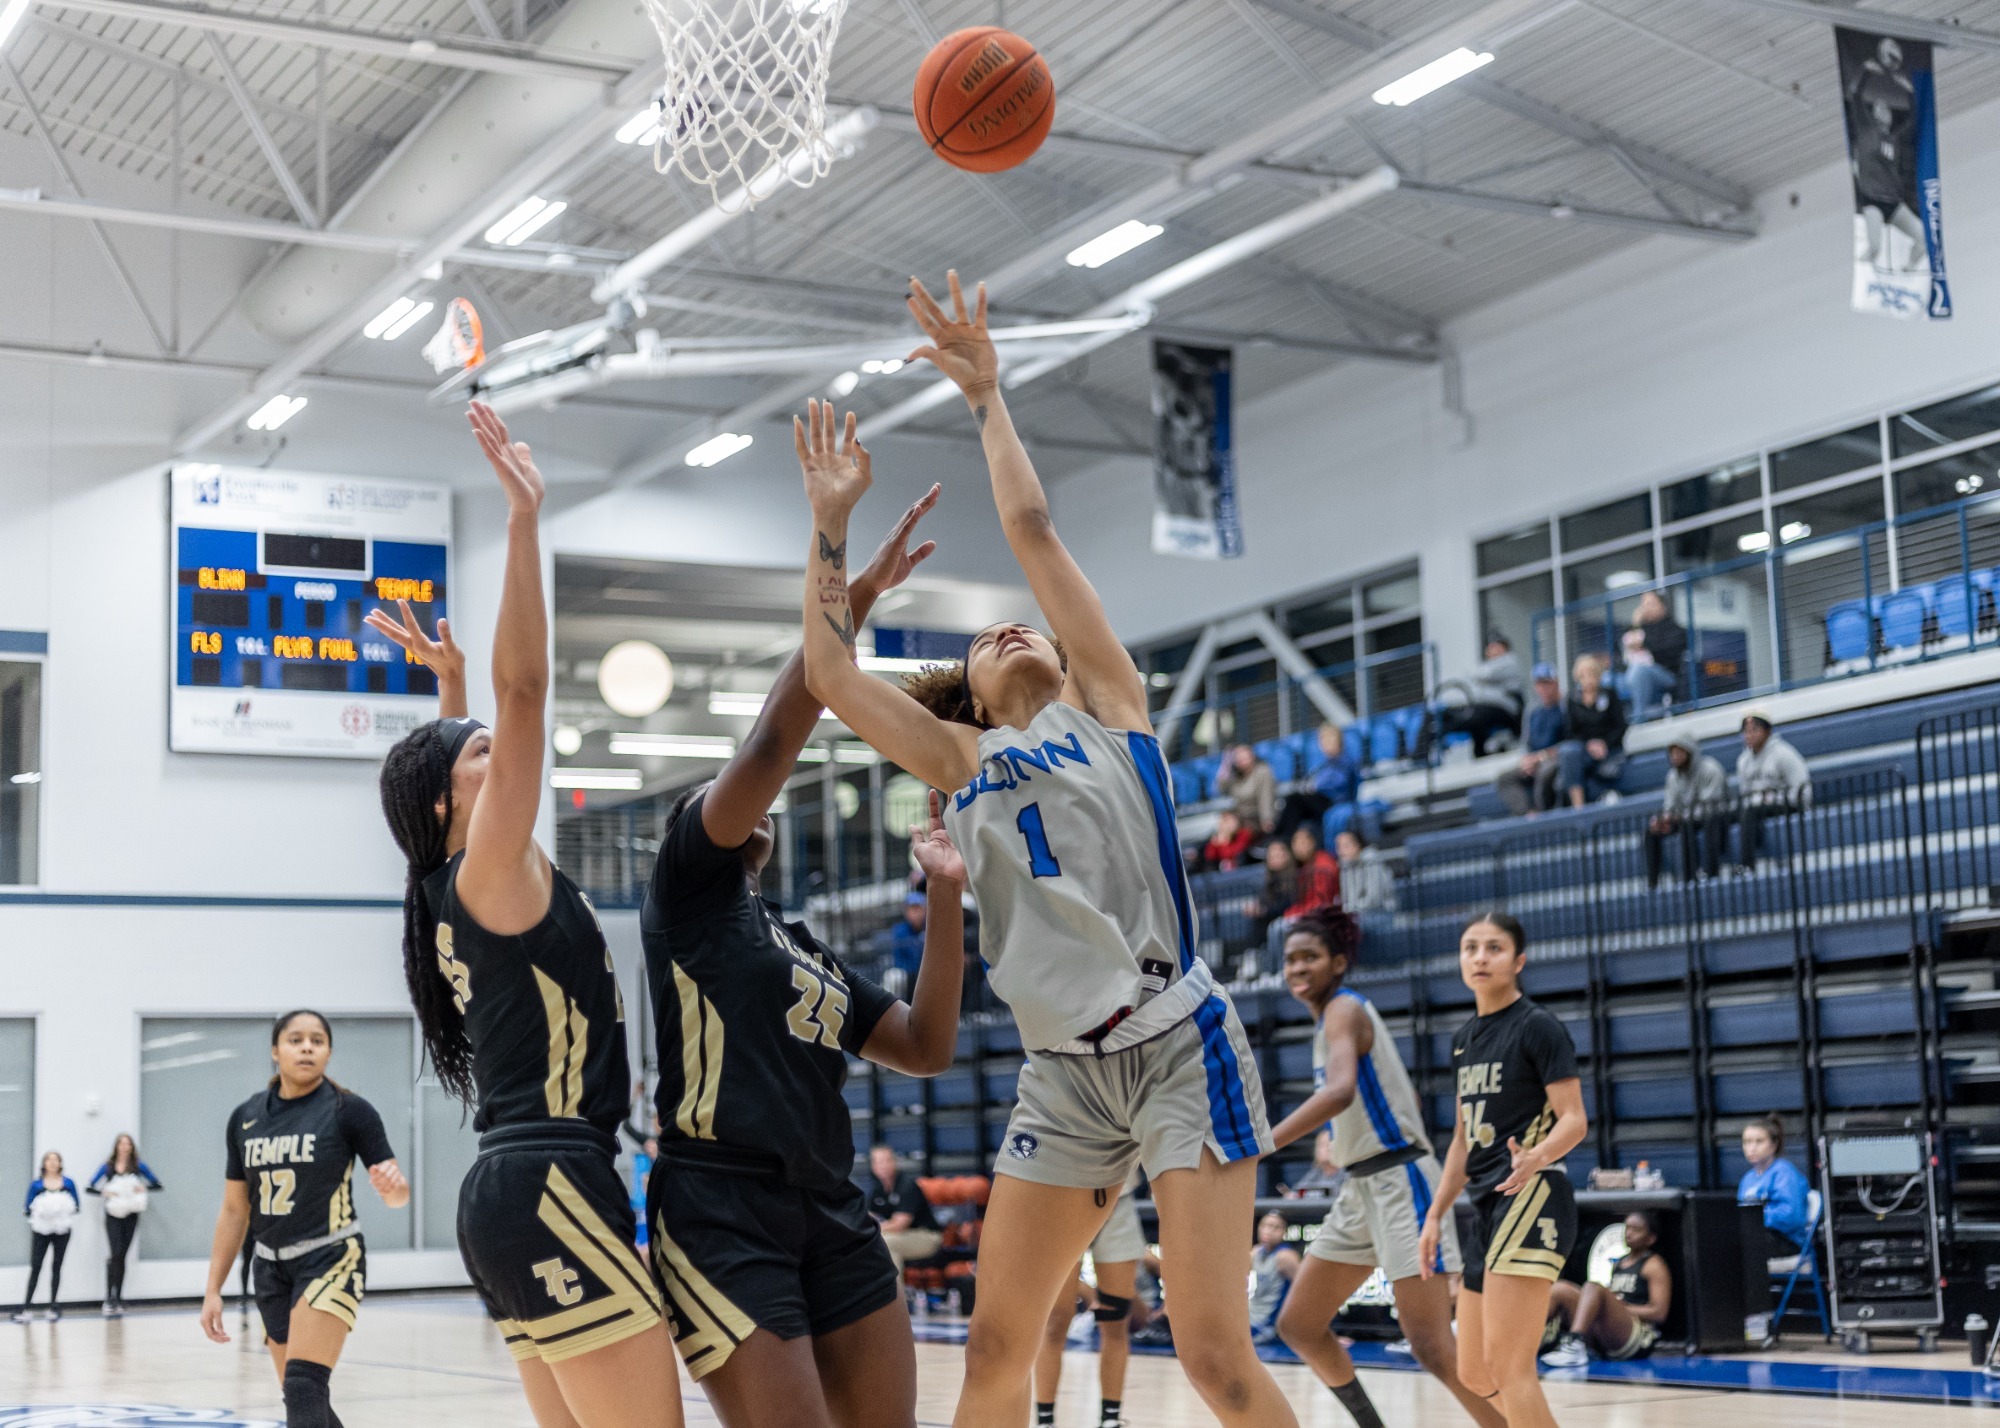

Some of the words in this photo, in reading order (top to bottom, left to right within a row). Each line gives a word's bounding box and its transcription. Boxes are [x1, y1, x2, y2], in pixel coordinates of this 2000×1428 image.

[968, 61, 1046, 138] SPALDING
[199, 567, 246, 591] BLINN
[375, 577, 433, 602] TEMPLE
[192, 631, 222, 654] FLS
[319, 637, 358, 662] FOUL
[1016, 801, 1062, 879] 1
[1151, 963, 1160, 973] L
[786, 963, 848, 1050] 25
[244, 1134, 316, 1168] TEMPLE
[259, 1168, 297, 1216] 12
[532, 1257, 584, 1307] TC
